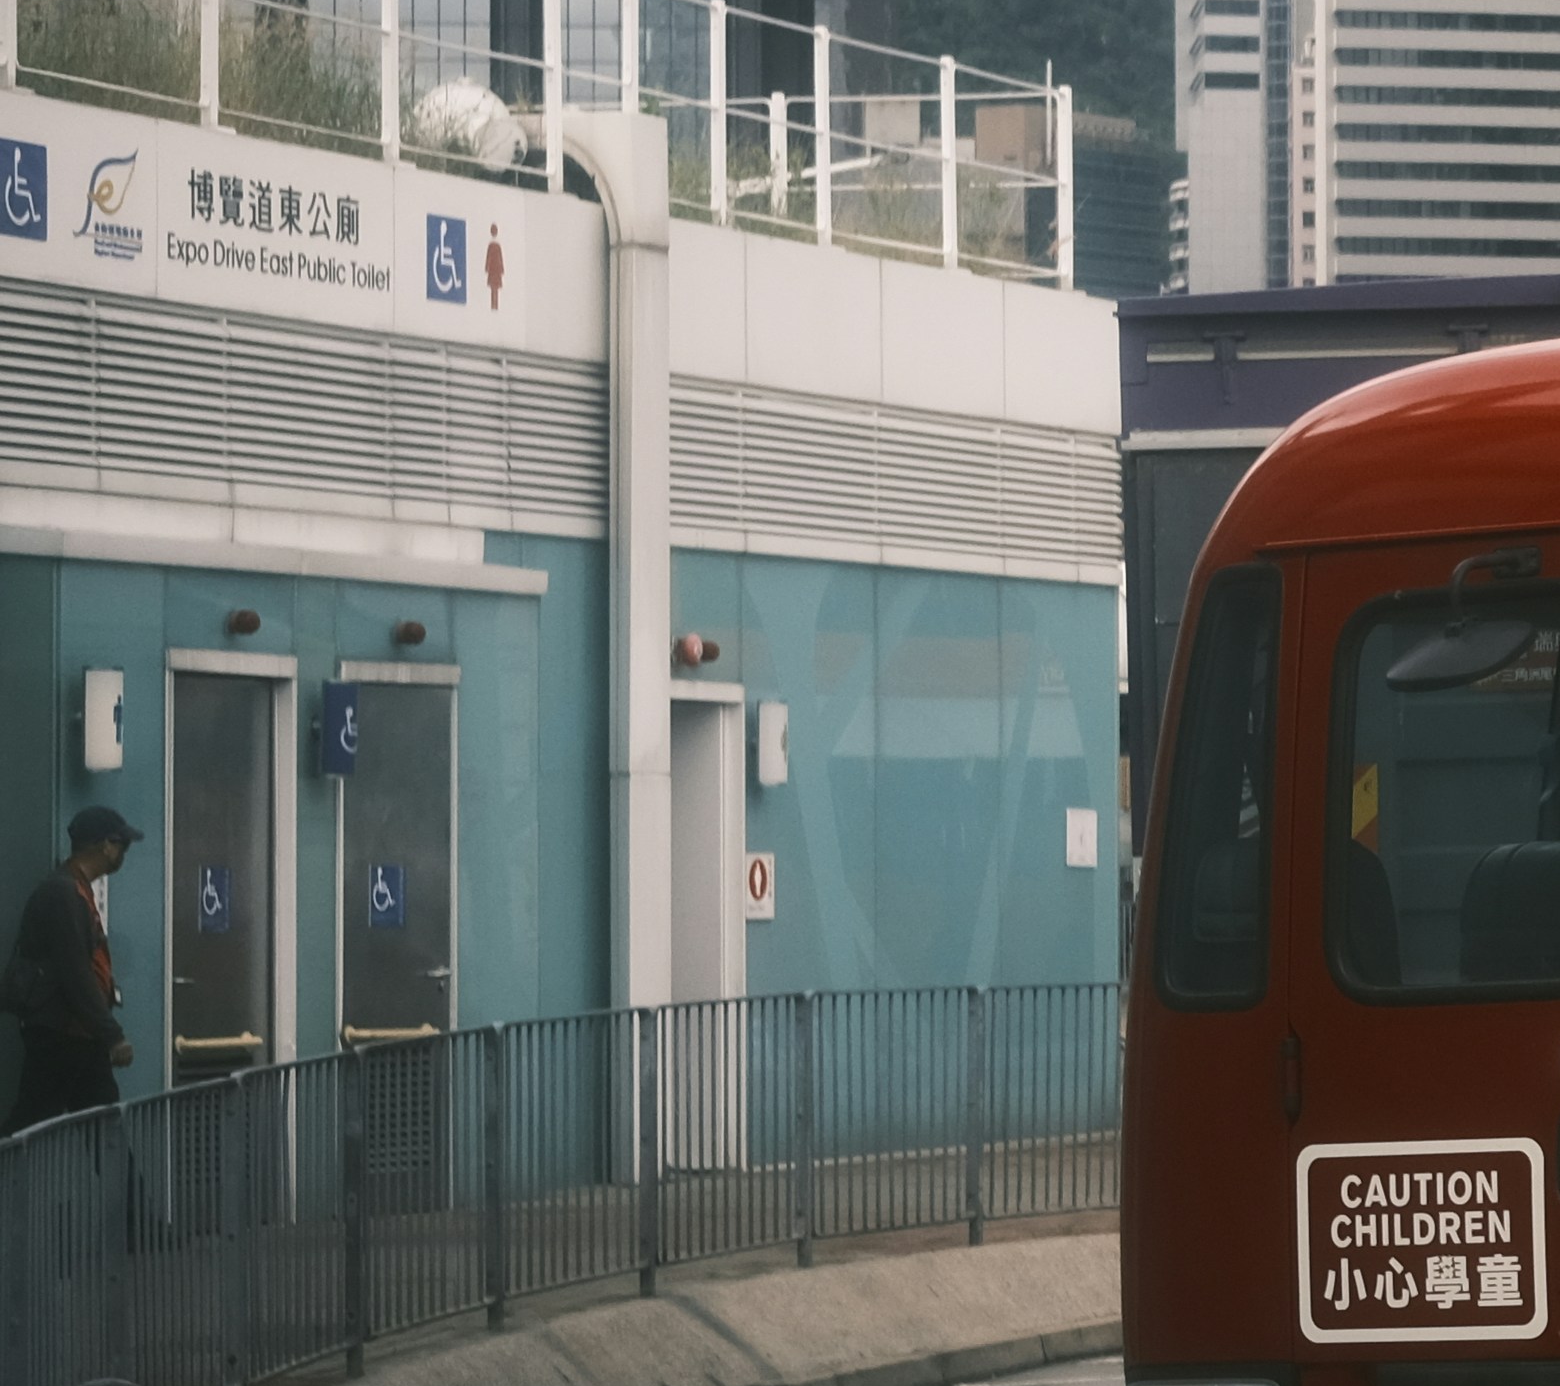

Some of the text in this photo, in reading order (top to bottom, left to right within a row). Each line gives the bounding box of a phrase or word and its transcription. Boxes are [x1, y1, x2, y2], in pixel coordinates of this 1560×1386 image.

[188, 167, 361, 247] 博覽道東公廁
[167, 231, 209, 268] Expo
[213, 239, 256, 273] Drive
[260, 246, 293, 277] East
[297, 253, 346, 286] Public
[350, 261, 391, 293] Toilet
[1340, 1170, 1500, 1209] CAUTION
[1330, 1210, 1512, 1248] CHILDREN
[1323, 1253, 1524, 1311] 小心學童
